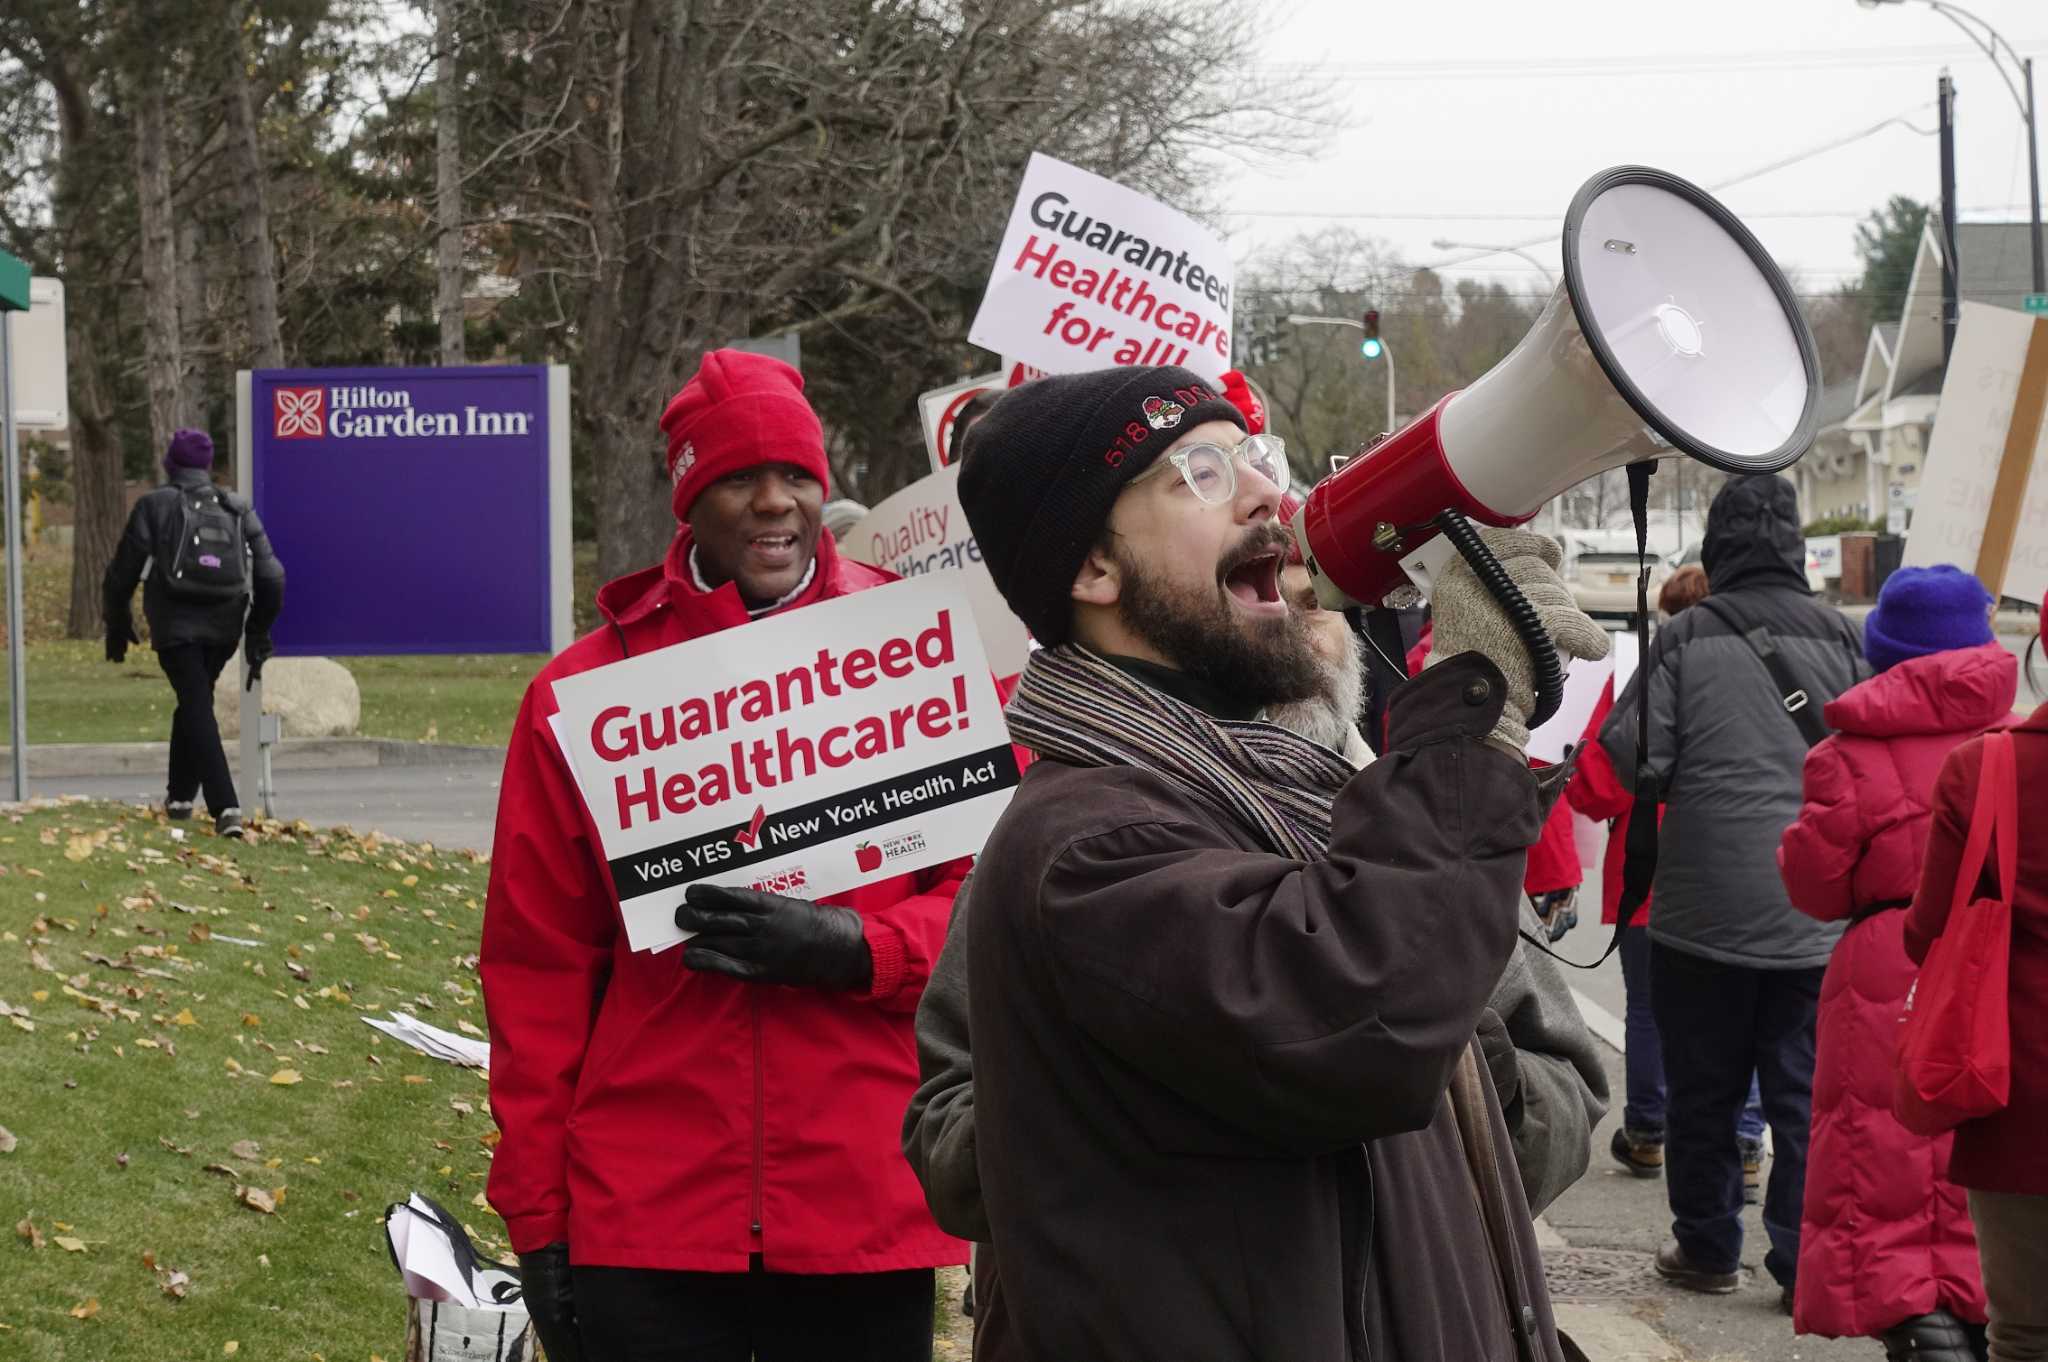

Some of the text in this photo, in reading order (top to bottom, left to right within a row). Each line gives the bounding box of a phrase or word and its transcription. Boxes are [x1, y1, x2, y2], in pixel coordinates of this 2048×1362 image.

[1030, 191, 1229, 313] Guaranteed
[1013, 234, 1228, 358] Healthcare
[1042, 302, 1115, 352] for
[328, 406, 529, 438] Garden Inn
[330, 387, 411, 409] Hilton
[1104, 421, 1149, 468] 518
[871, 504, 949, 568] Quality
[590, 608, 956, 762] Guaranteed
[613, 675, 971, 831] Healthcare!
[634, 760, 997, 882] Vote YES New York Health Act
[883, 839, 901, 849] NEW
[885, 839, 927, 859] HEALTH
